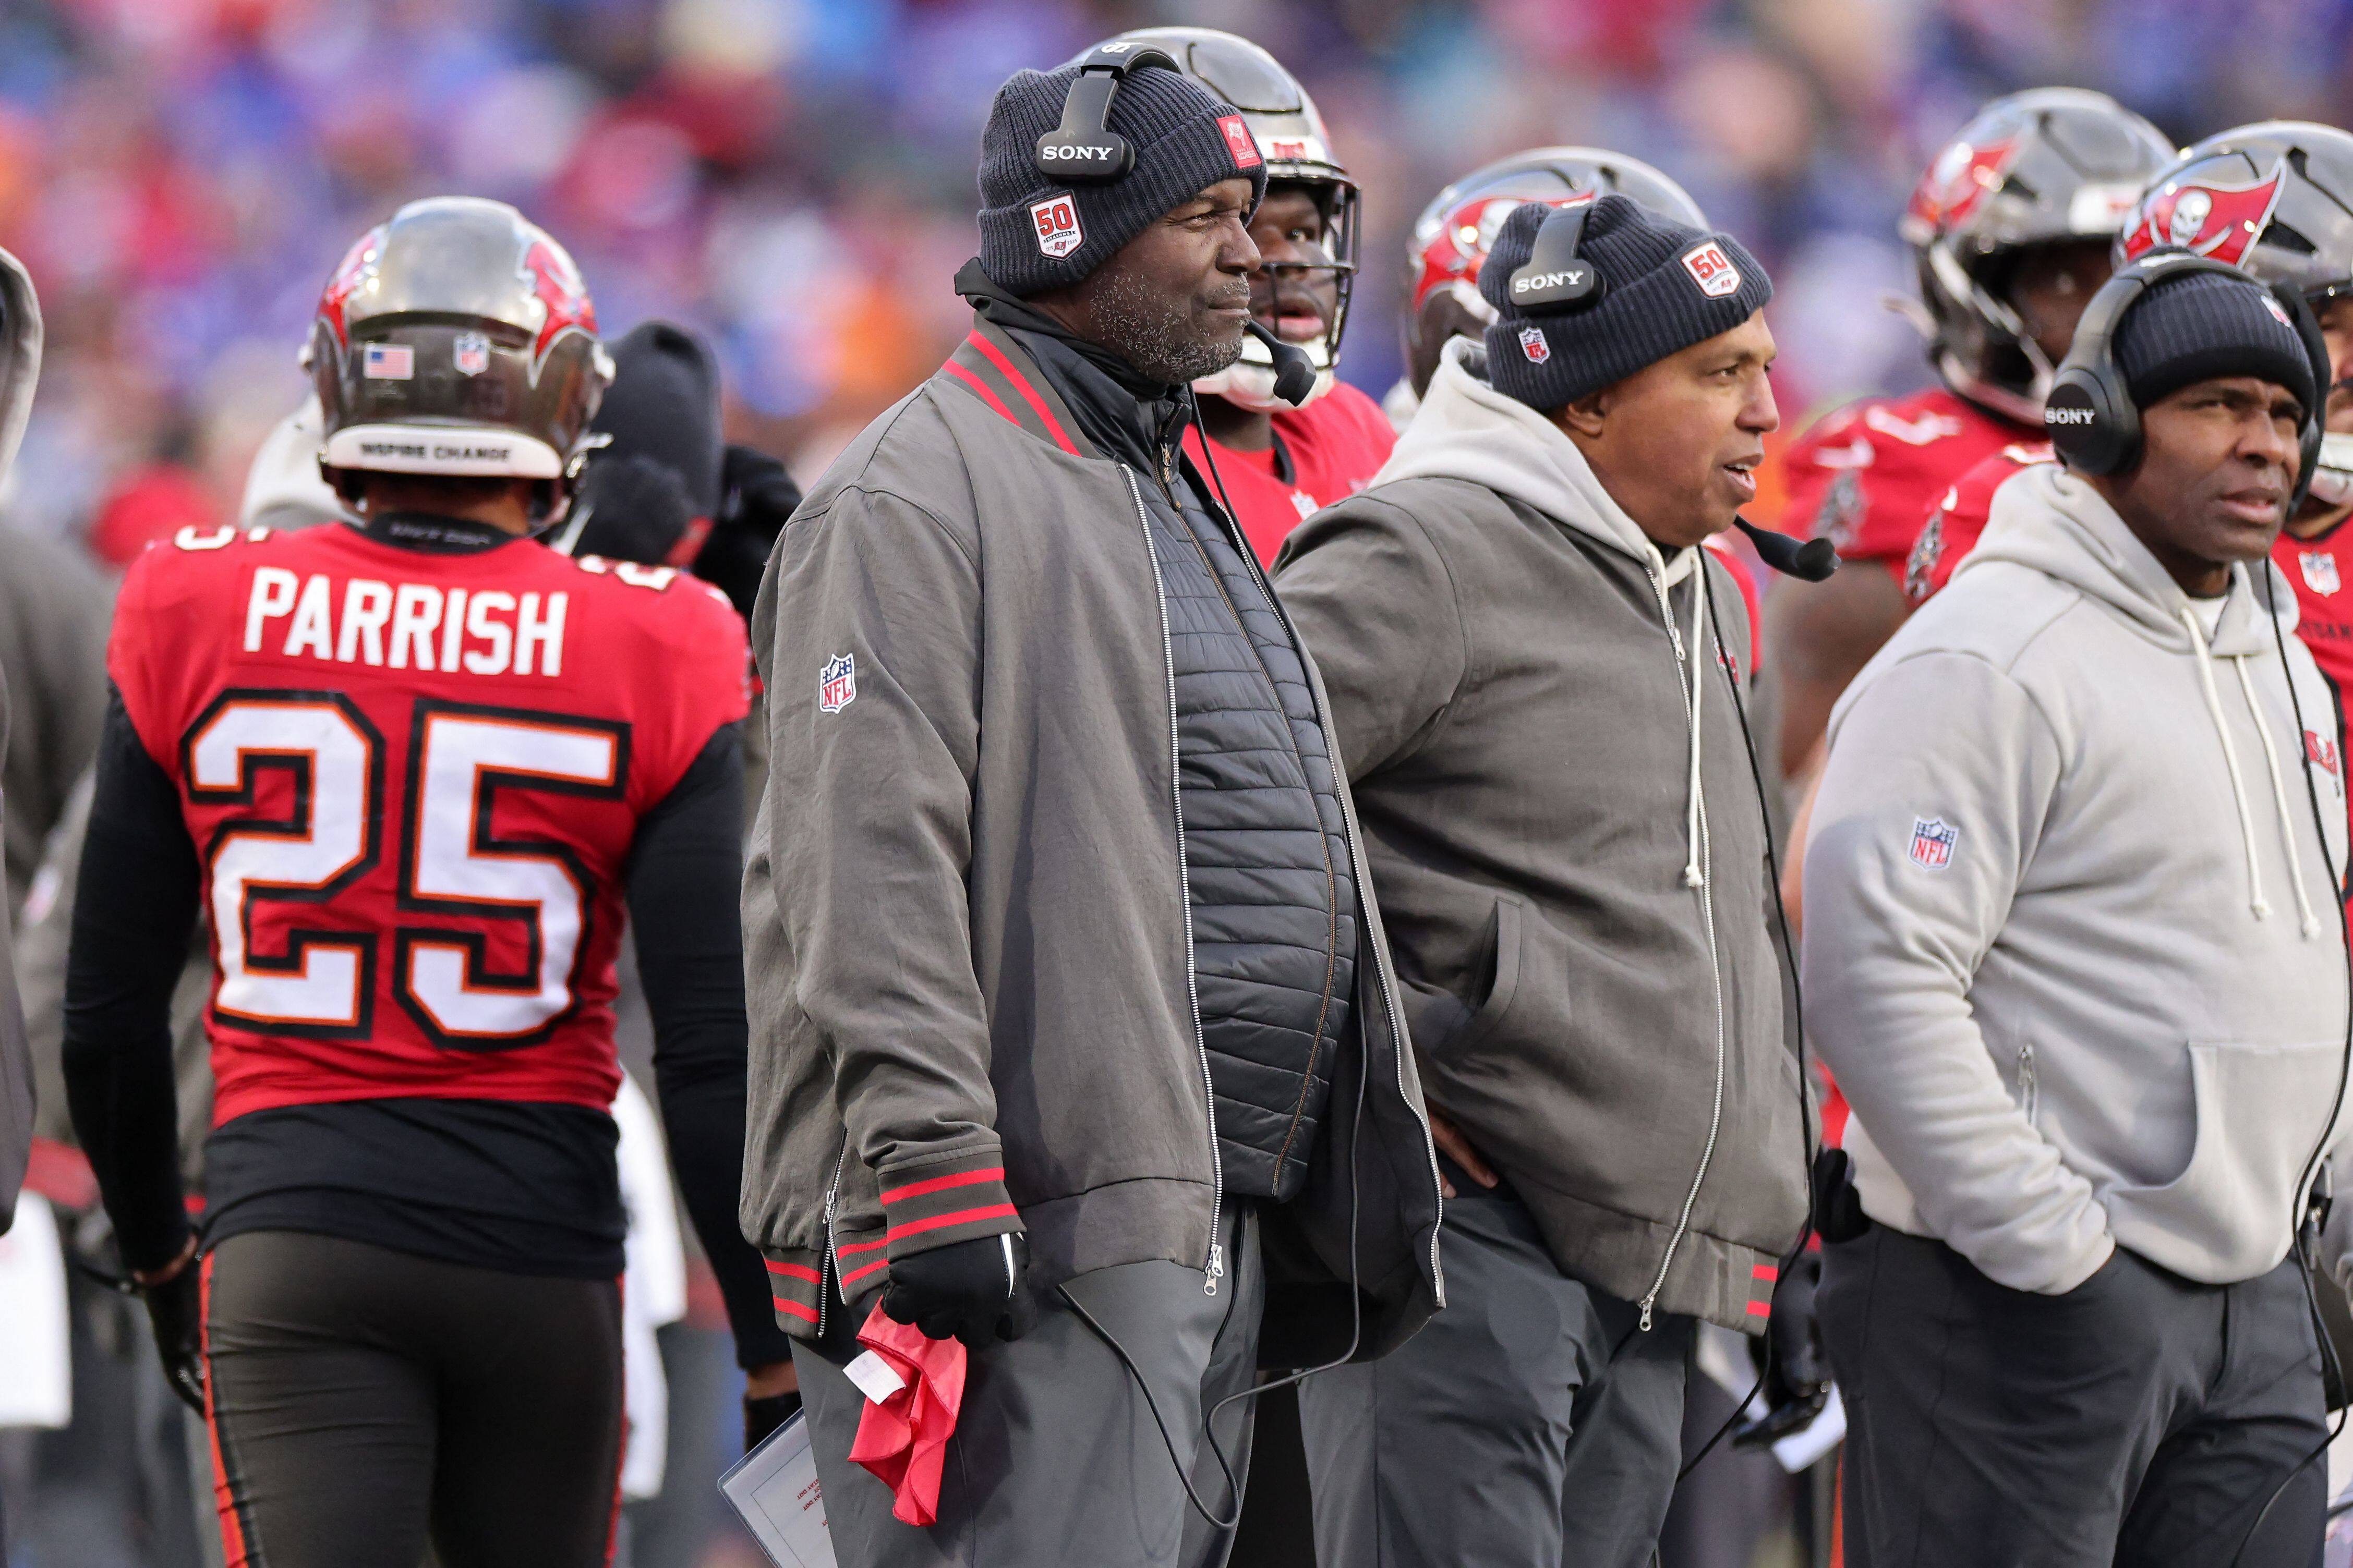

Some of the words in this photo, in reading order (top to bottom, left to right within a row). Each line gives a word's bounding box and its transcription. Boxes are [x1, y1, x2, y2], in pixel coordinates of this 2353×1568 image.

[1043, 145, 1113, 160] SONY
[1035, 203, 1073, 236] 50
[1690, 250, 1728, 279] 50
[1515, 270, 1584, 294] SONY
[2045, 407, 2095, 424] SONY
[243, 566, 568, 677] PARRISH
[823, 677, 851, 706] NFL
[1913, 836, 1947, 865] NFL
[180, 687, 632, 1052] 25
